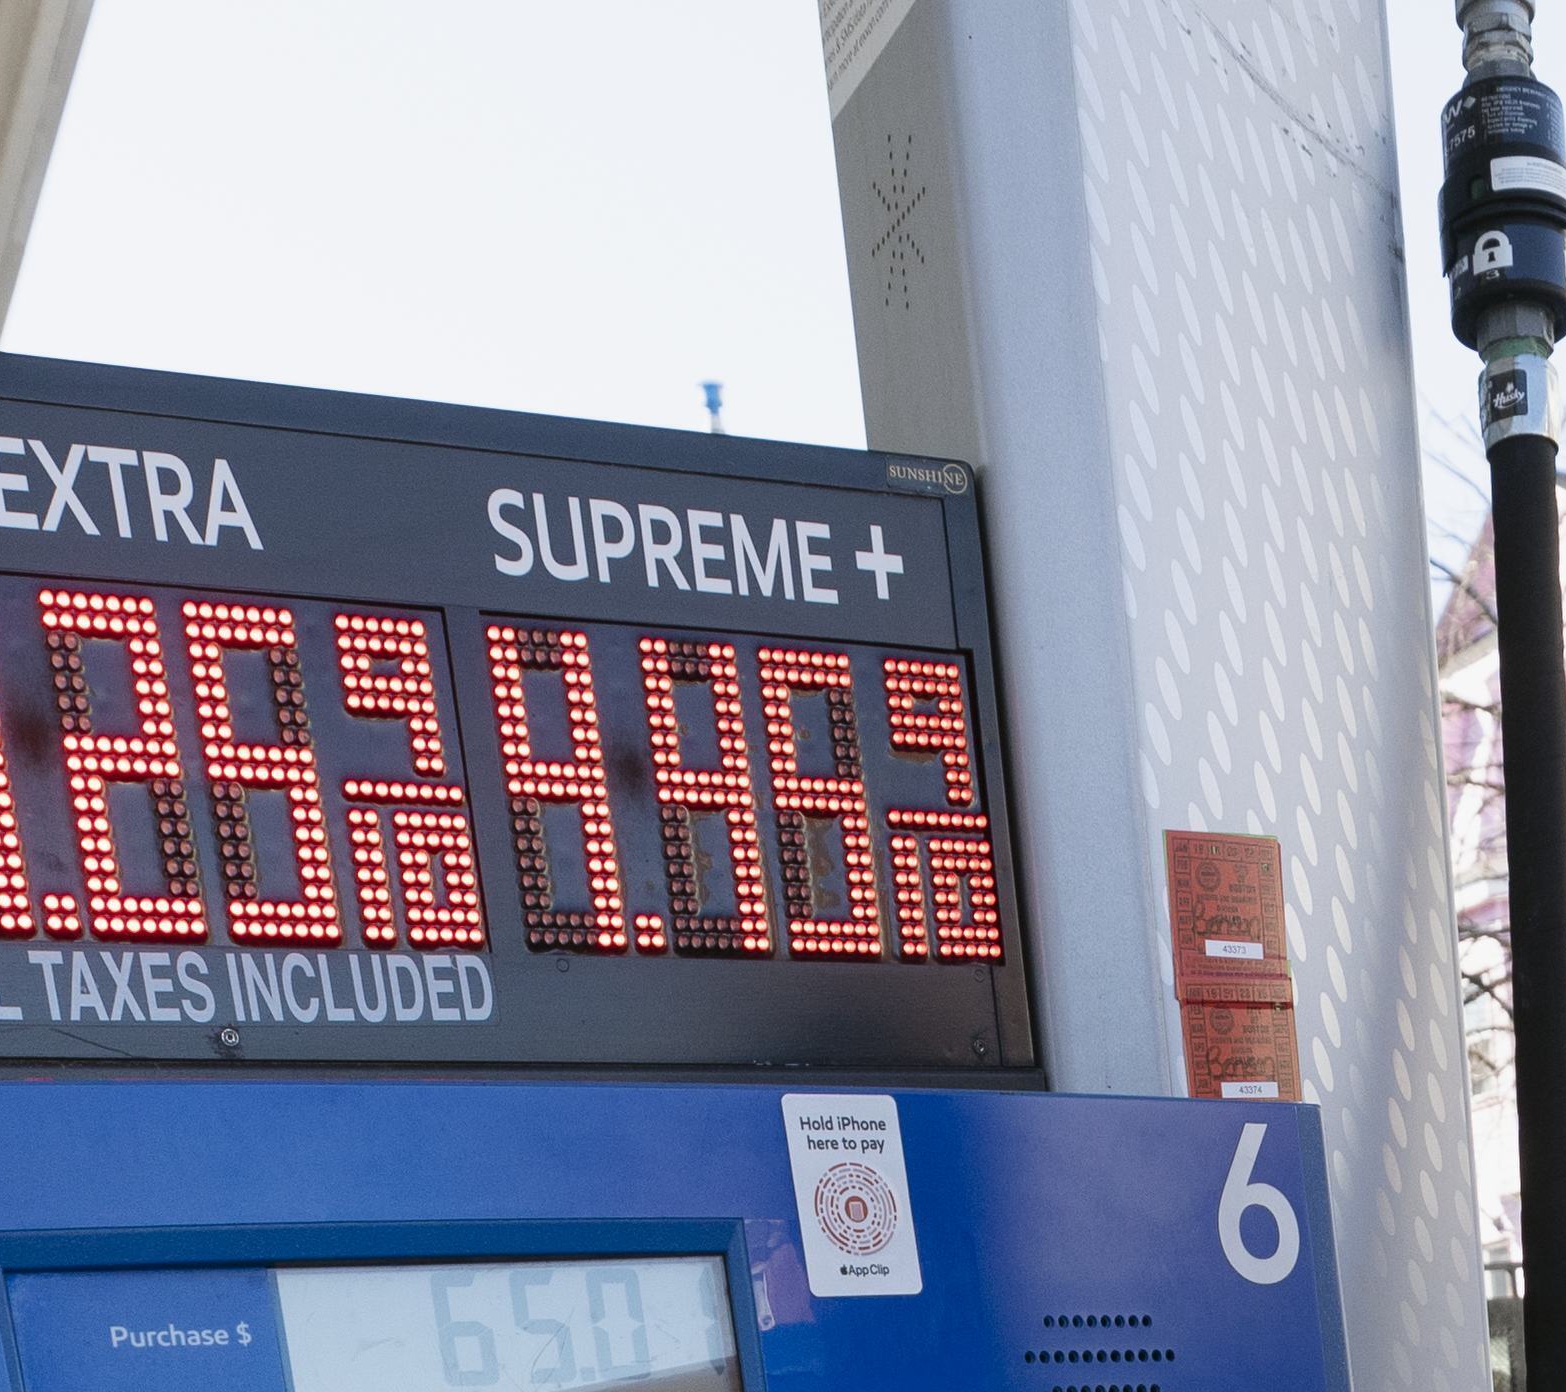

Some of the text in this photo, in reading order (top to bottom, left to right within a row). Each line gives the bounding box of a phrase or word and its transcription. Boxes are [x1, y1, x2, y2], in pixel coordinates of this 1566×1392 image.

[889, 465, 964, 487] SUNSHINE
[487, 488, 839, 605] SUPREME
[1222, 944, 1246, 955] 43373
[33, 950, 214, 1024] TAXES
[226, 953, 495, 1024] INCLUDED
[1239, 1085, 1263, 1094] 43374
[799, 1115, 887, 1133] Hold iPhone
[807, 1135, 885, 1154] here to pay
[1218, 1123, 1300, 1285] 6
[848, 1263, 890, 1279] App Clip
[110, 1320, 253, 1350] Purchase $
